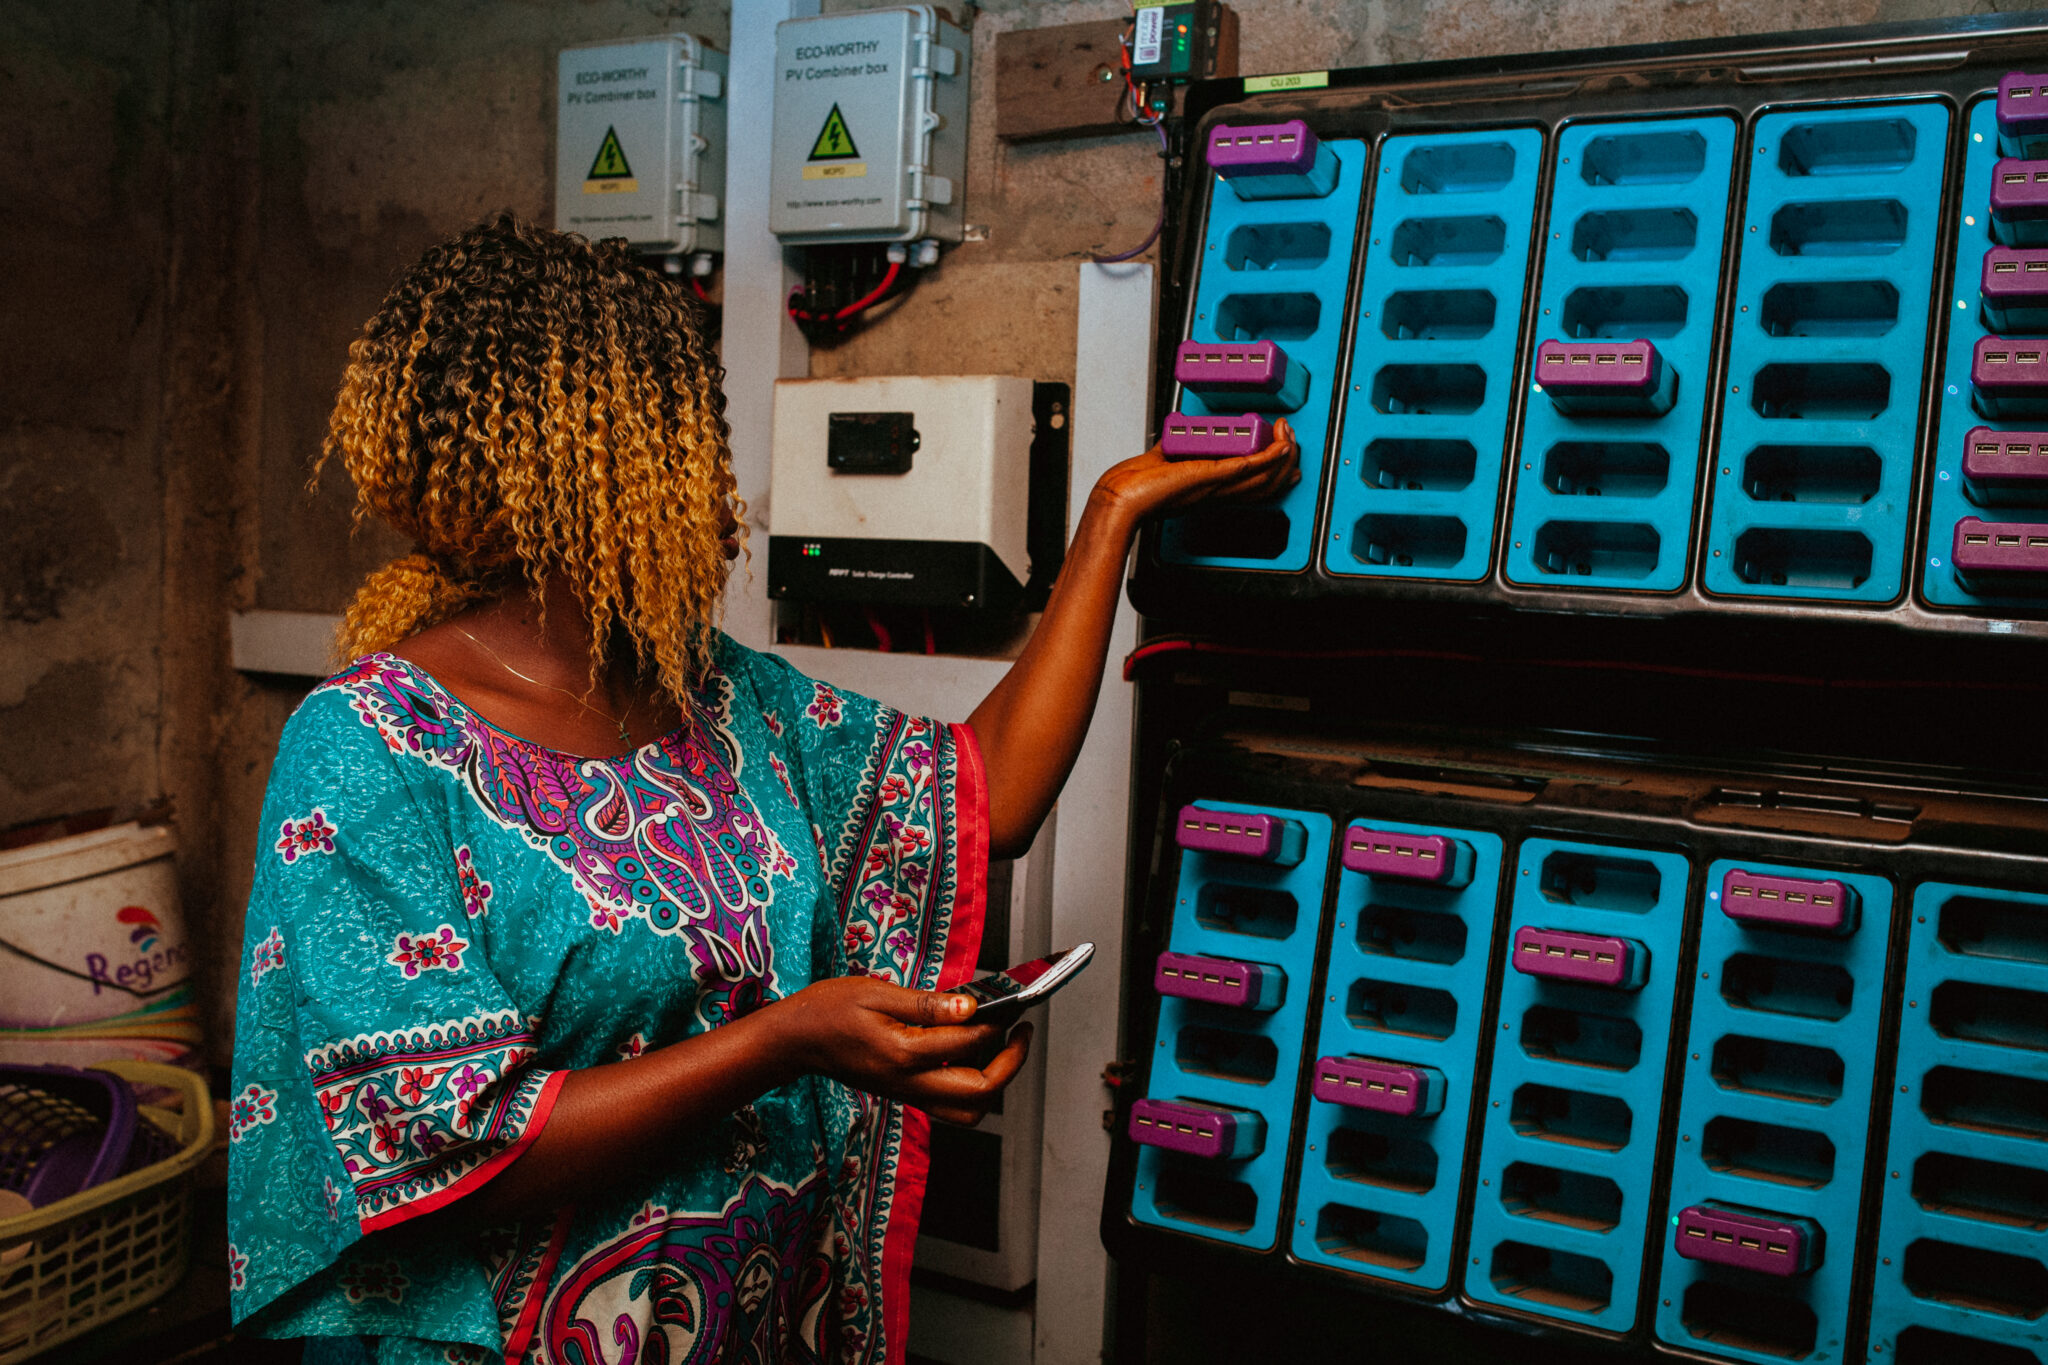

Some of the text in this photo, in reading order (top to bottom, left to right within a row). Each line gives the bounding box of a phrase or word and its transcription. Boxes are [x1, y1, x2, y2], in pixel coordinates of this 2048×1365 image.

[796, 40, 880, 60] ECO-WORTHY
[576, 68, 649, 85] ECO-WORTHY
[785, 62, 888, 81] PV Combiner box
[567, 89, 656, 104] PV Combiner box
